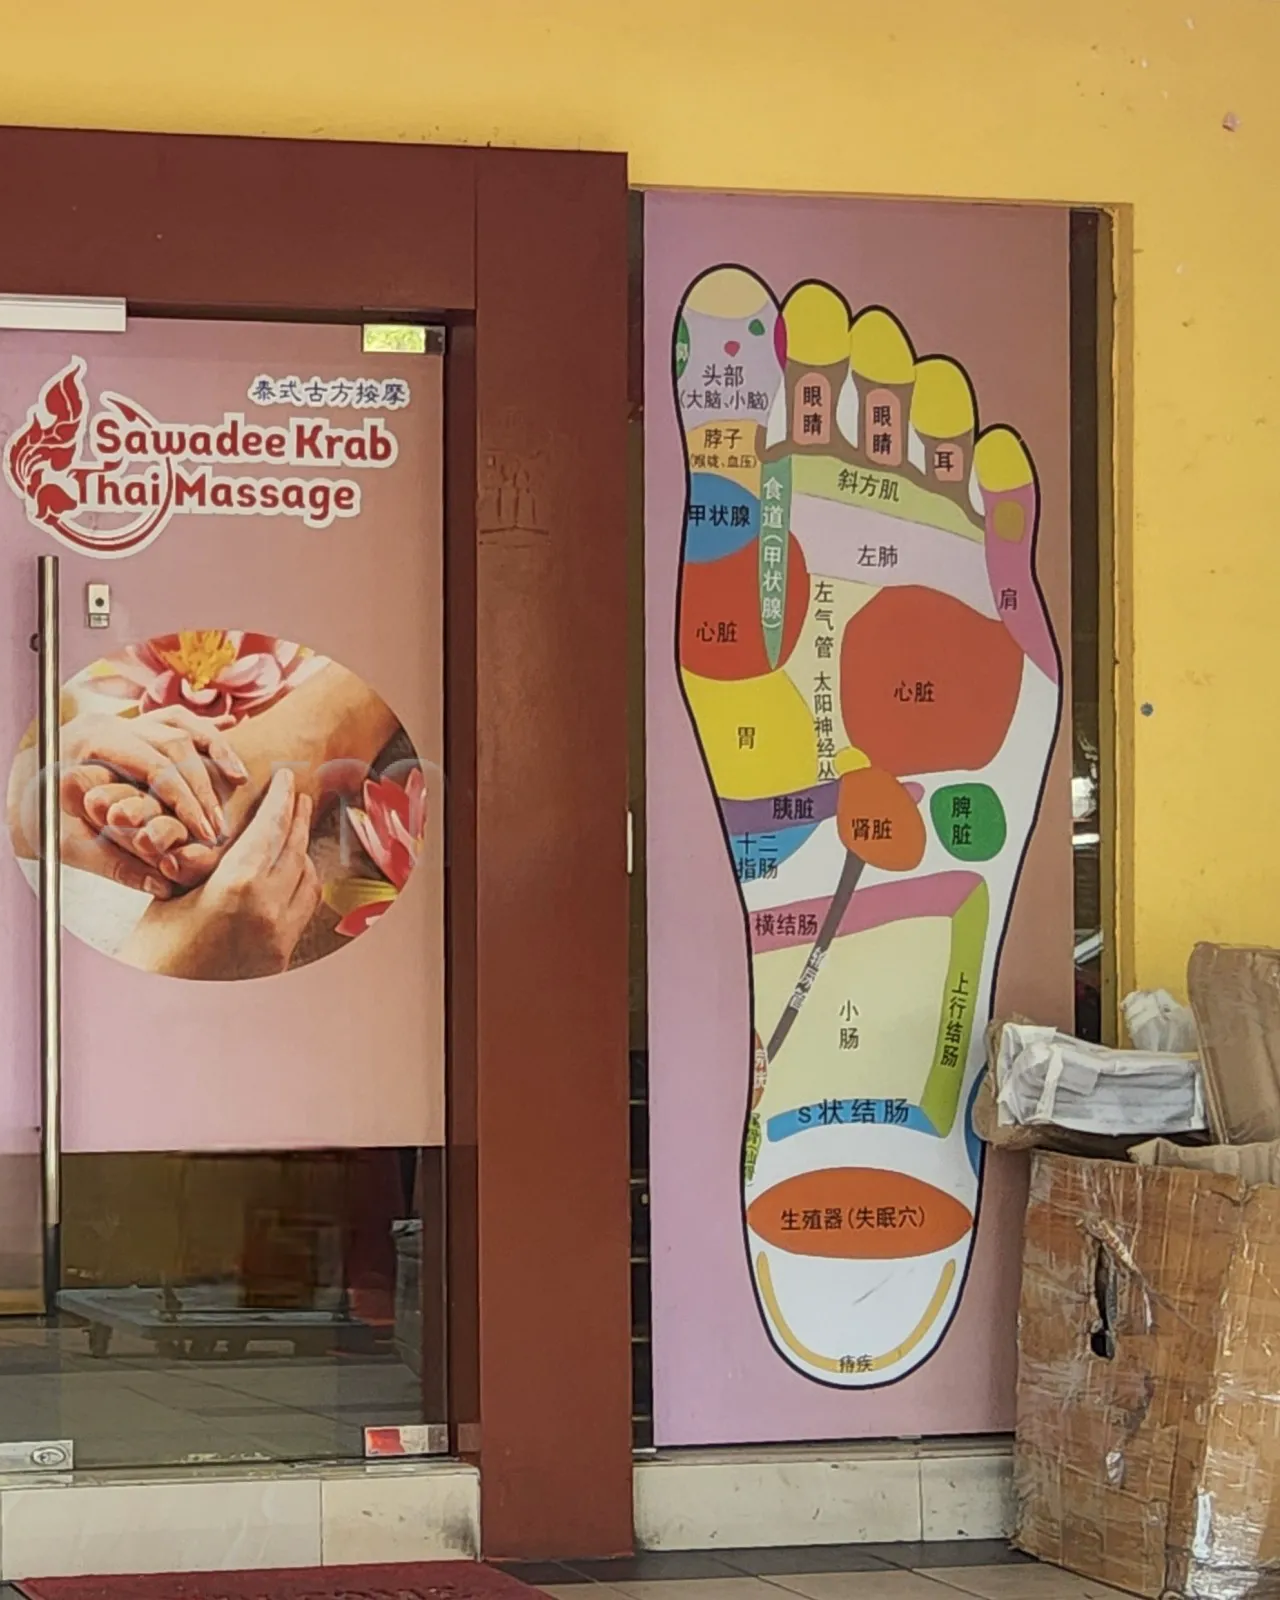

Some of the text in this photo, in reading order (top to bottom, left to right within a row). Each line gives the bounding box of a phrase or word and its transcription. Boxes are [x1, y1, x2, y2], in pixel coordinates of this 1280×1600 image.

[702, 363, 745, 387] 头部
[252, 378, 407, 405] 泰式古方按摩
[803, 386, 823, 435] 眼睛
[95, 418, 393, 462] Sawadee Krab
[704, 428, 742, 450] 脖子
[873, 406, 892, 455] 眼睛
[934, 451, 954, 472] 耳
[67, 458, 355, 520] Thai Massage
[838, 469, 900, 503] 斜方肌
[688, 505, 750, 528] 甲状腺
[857, 545, 899, 566] 左肺
[999, 590, 1017, 611] 肩
[696, 622, 737, 643] 心脏
[814, 582, 835, 659] 左气管
[894, 682, 935, 704] 心脏
[737, 727, 756, 750] 胃
[813, 671, 836, 782] 太阳神经丛
[772, 798, 815, 820] 胰脏
[851, 820, 892, 841] 肾脏
[951, 796, 972, 847] 脾脏
[737, 832, 779, 854] 十二
[737, 857, 778, 879] 指肠
[754, 913, 818, 936] 横结肠
[838, 1000, 859, 1050] 小肠
[940, 972, 969, 1067] 上行结肠
[798, 1098, 909, 1124] S状结肠
[781, 1207, 926, 1231] 生殖器(失眠穴)
